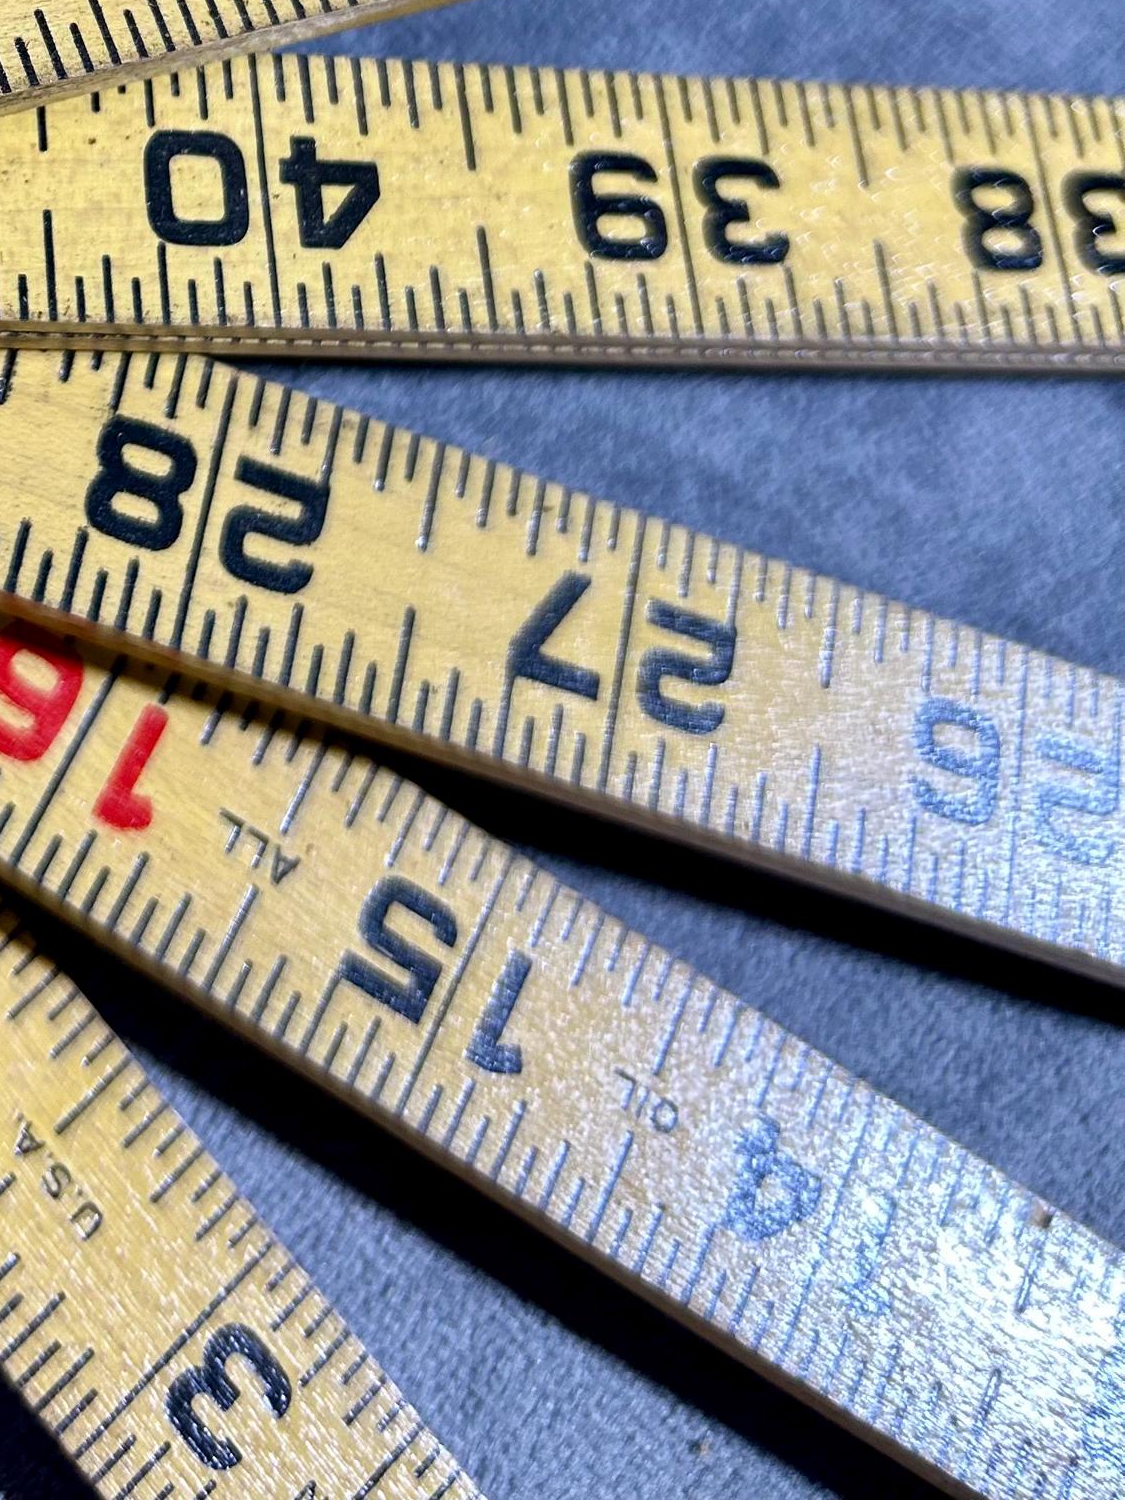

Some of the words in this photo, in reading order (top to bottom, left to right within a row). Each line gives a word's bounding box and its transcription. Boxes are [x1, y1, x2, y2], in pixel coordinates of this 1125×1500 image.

[145, 128, 381, 250] 40
[568, 150, 791, 266] 39
[85, 413, 332, 595] 28
[508, 571, 738, 735] 27
[218, 806, 301, 885] ALL
[911, 696, 1121, 866] 26
[335, 874, 535, 1076] 15
[613, 1067, 678, 1133] OIL
[165, 1322, 293, 1471] 3
